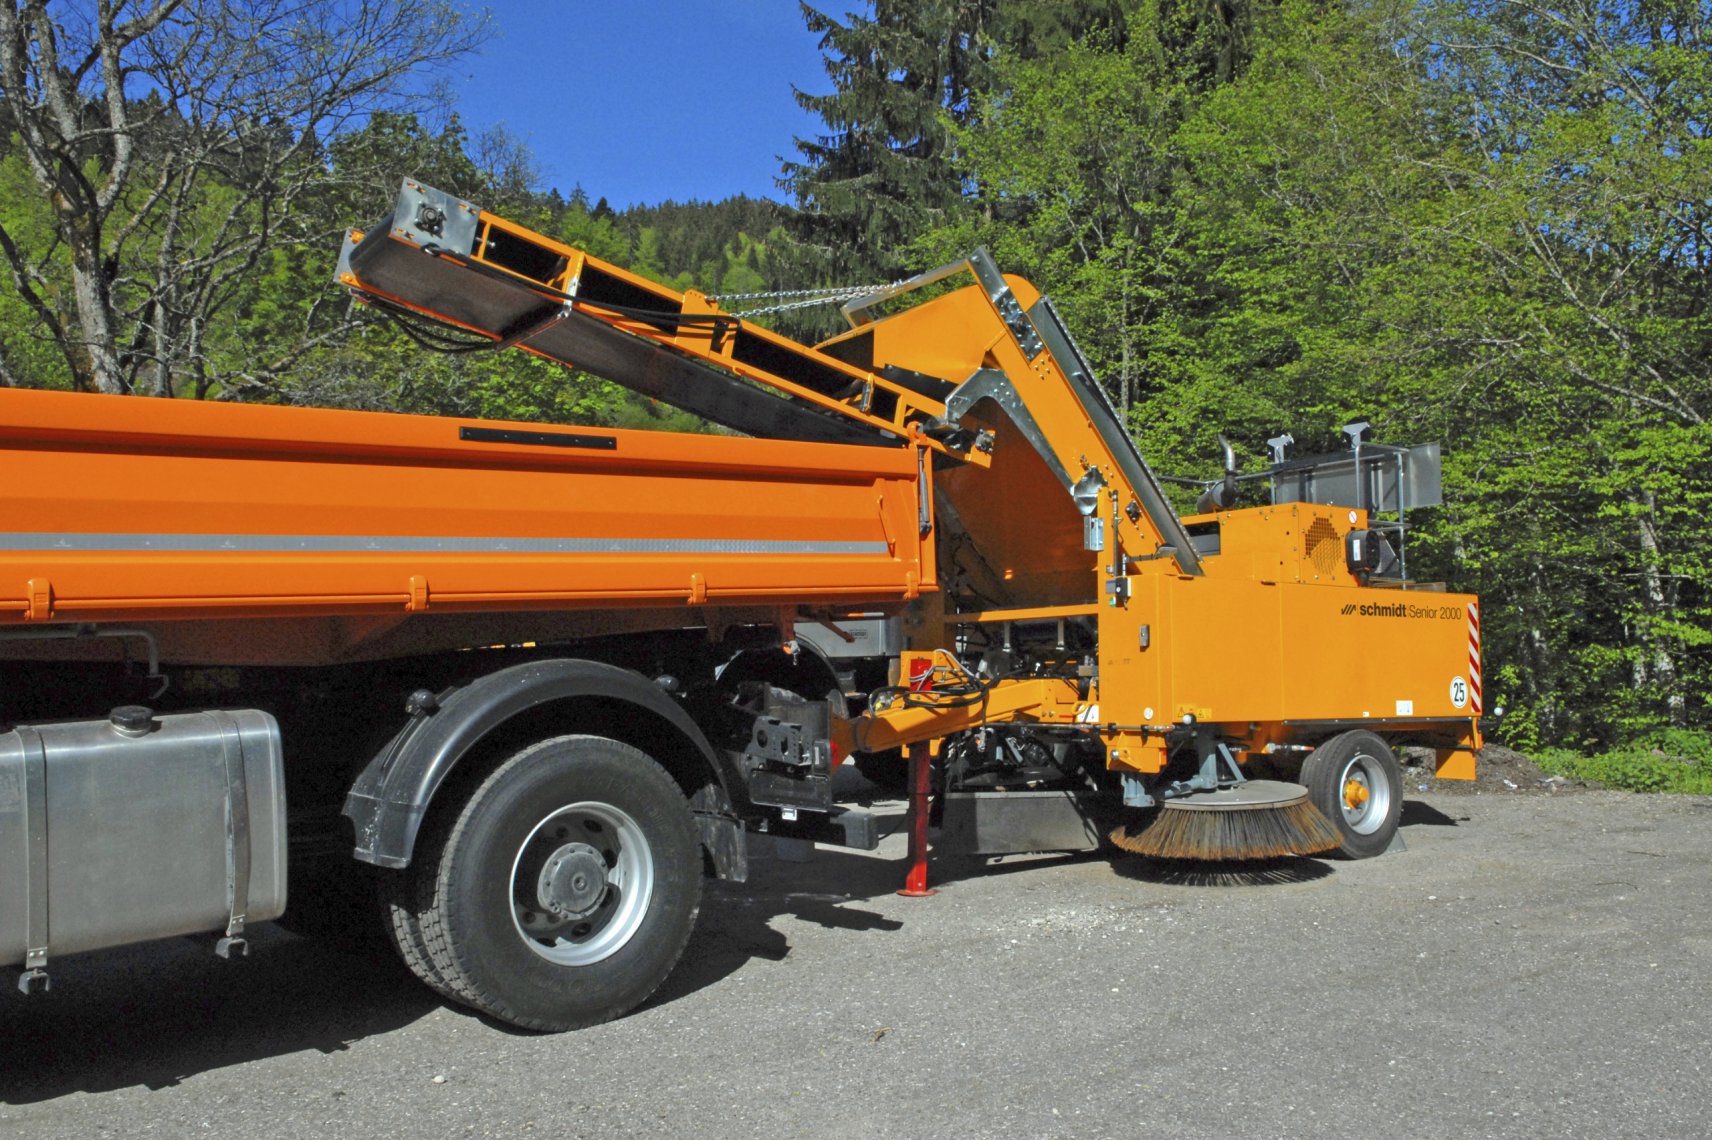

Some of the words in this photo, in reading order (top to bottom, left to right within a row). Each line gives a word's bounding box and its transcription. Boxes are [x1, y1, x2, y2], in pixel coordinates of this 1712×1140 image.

[1360, 602, 1406, 617] schmidt
[1409, 605, 1437, 619] Senior
[1440, 606, 1461, 620] 2000
[1453, 682, 1465, 702] 25
